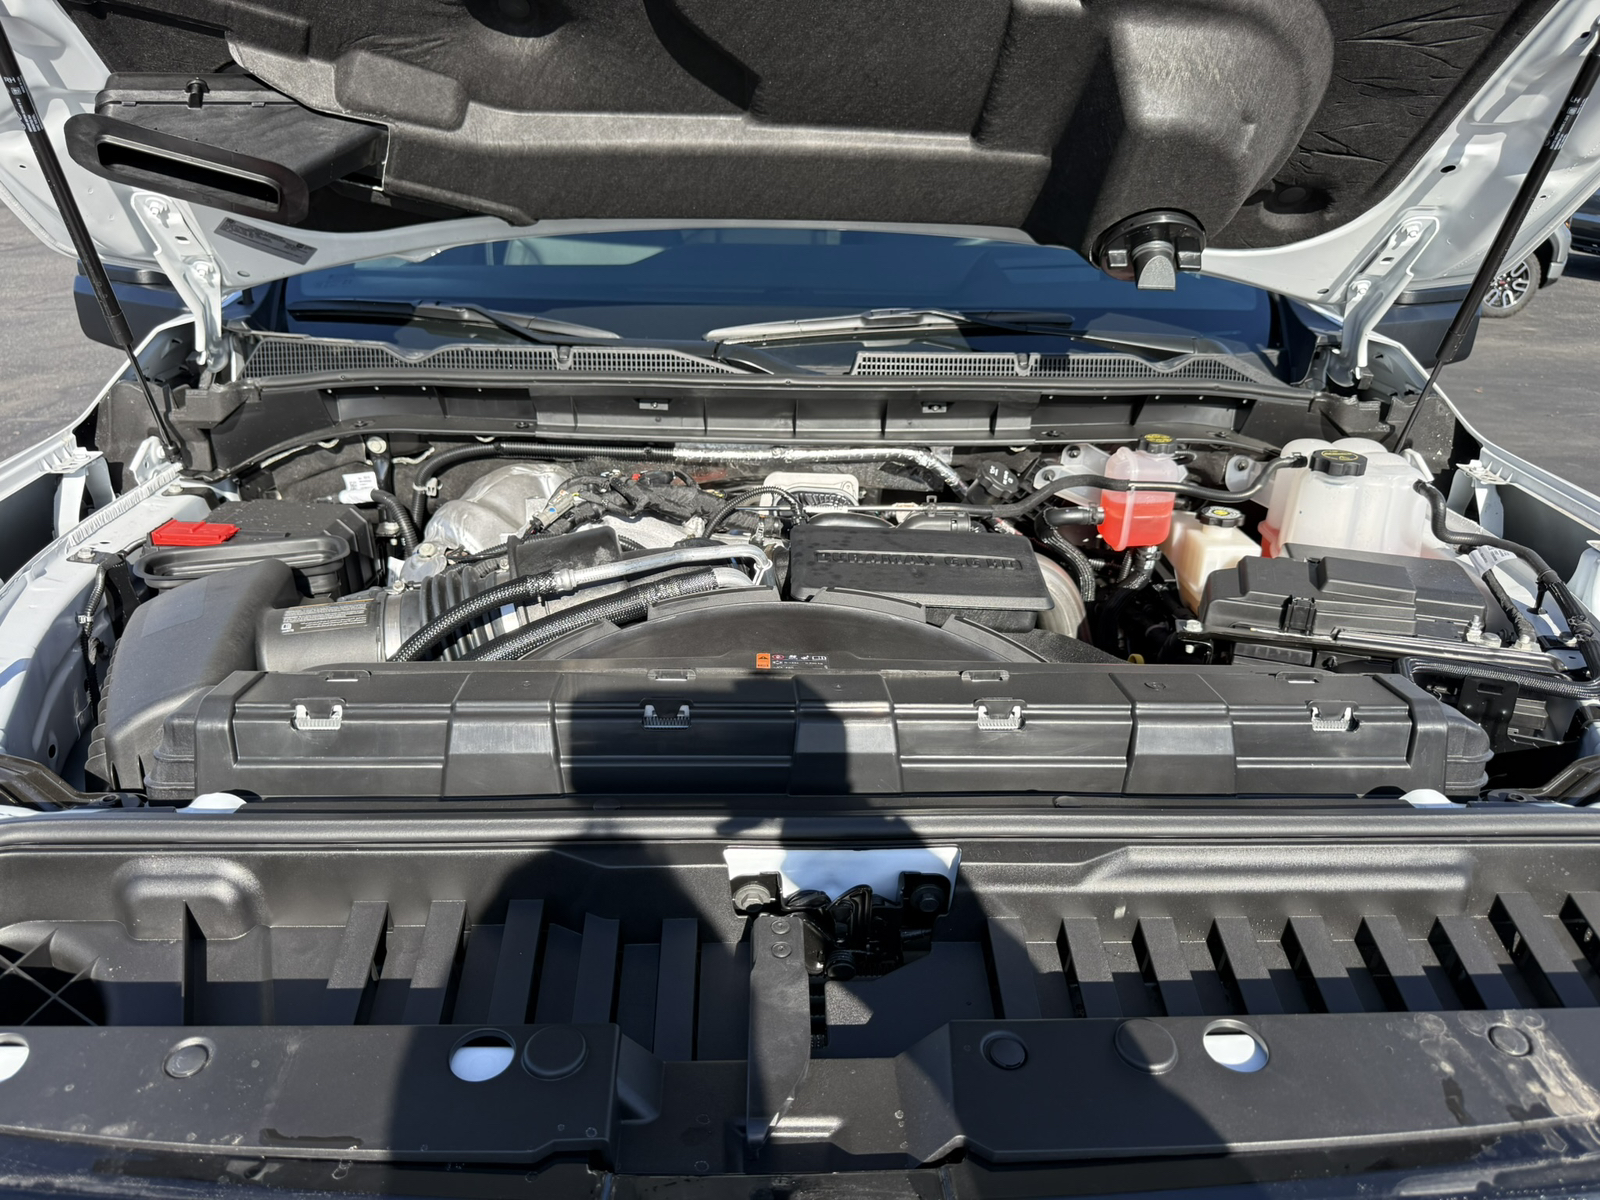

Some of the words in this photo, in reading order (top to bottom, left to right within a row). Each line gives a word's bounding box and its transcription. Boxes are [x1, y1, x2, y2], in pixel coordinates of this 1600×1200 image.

[3, 76, 17, 84] RH
[1570, 96, 1582, 104] LH
[814, 551, 936, 567] DURAMAX
